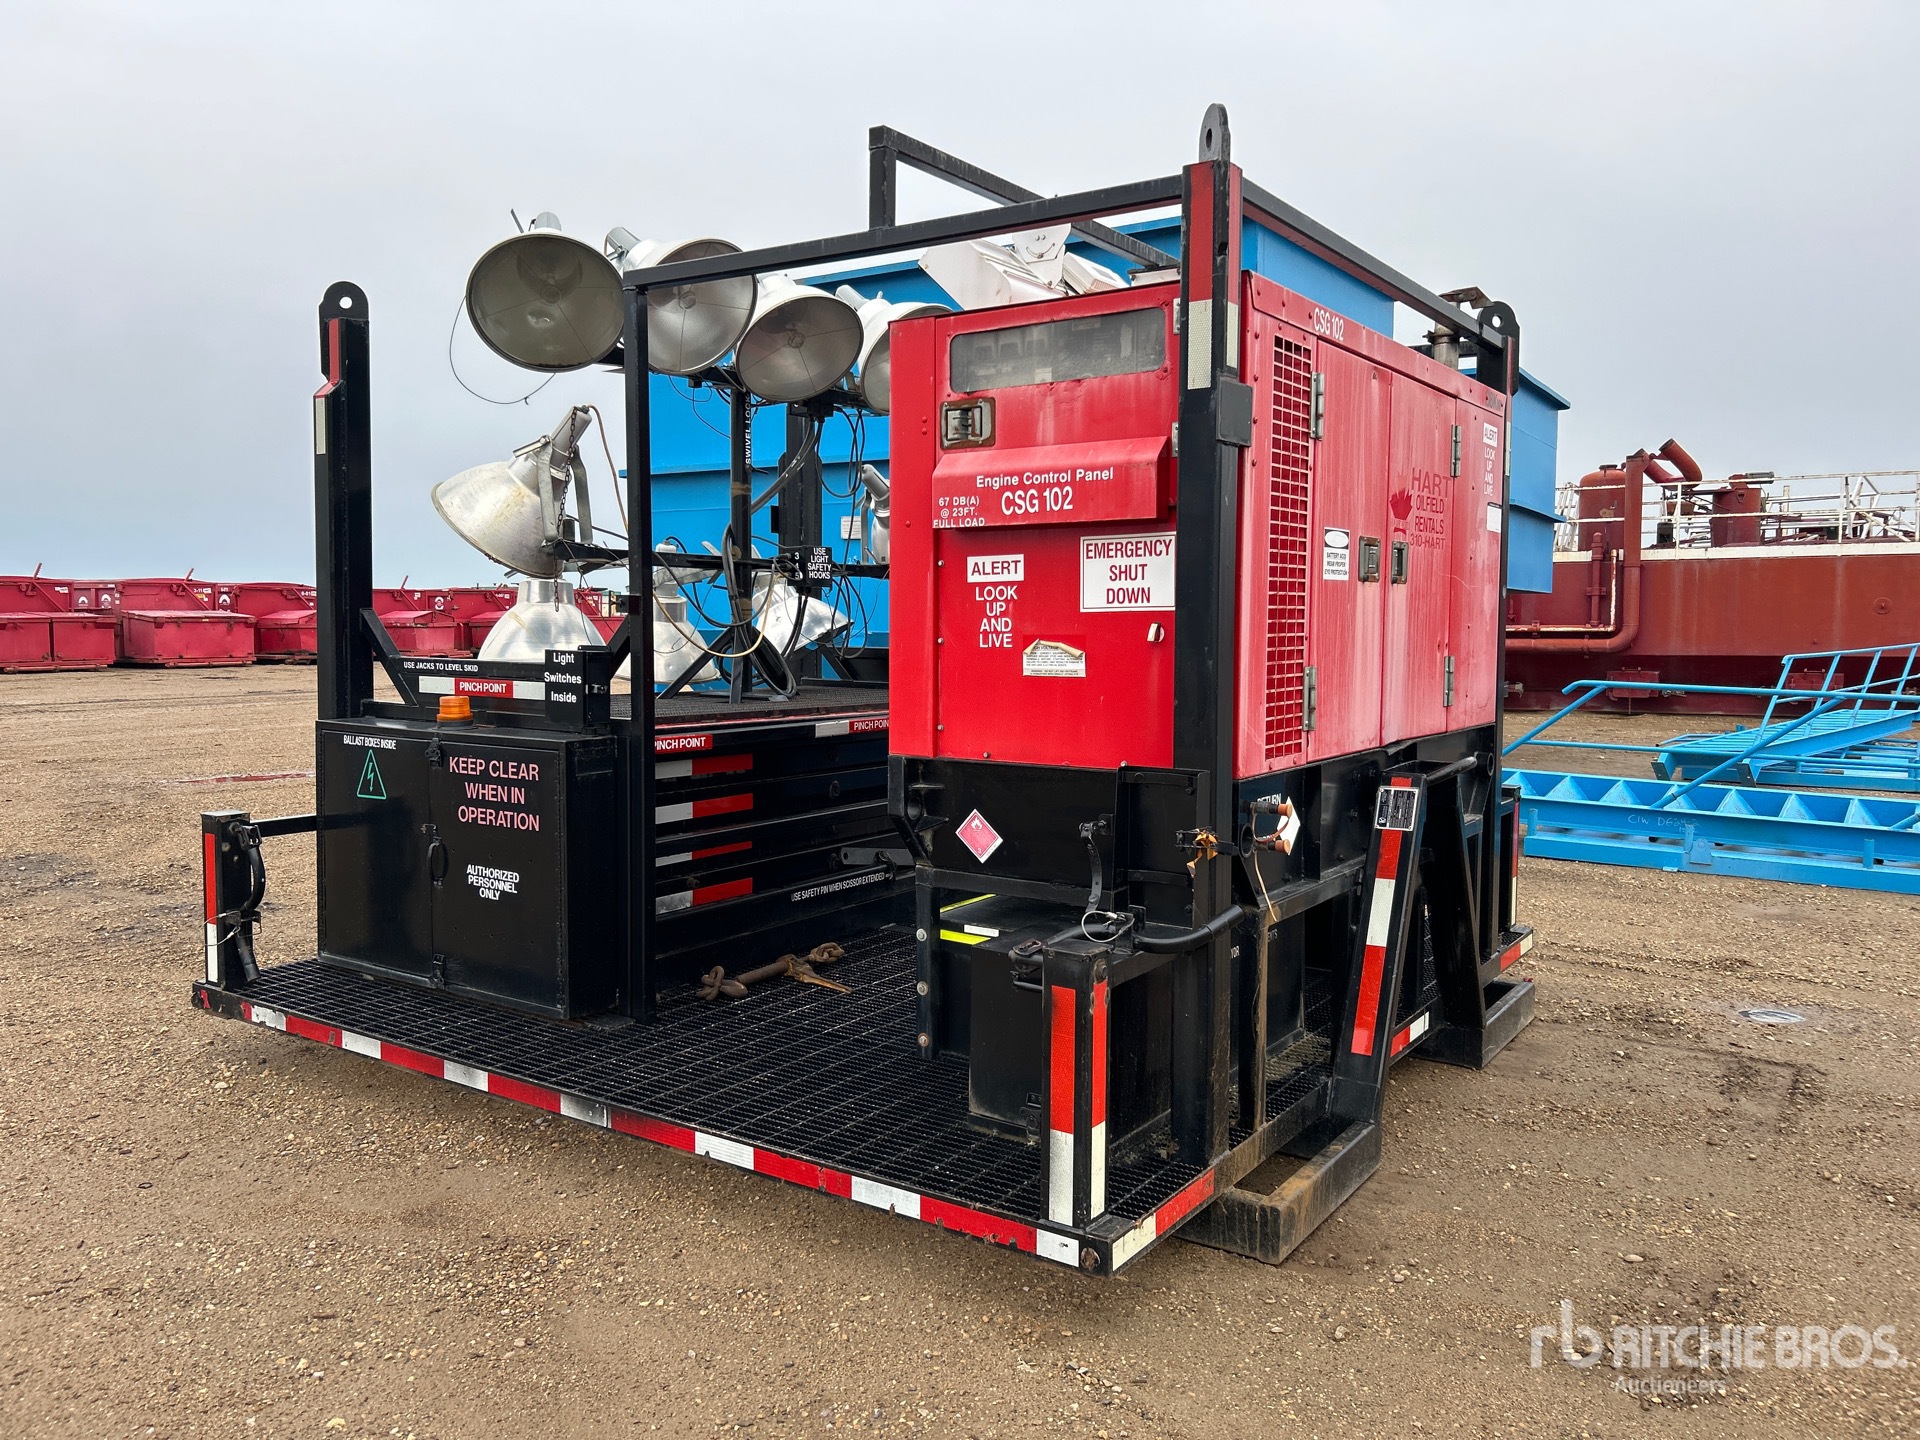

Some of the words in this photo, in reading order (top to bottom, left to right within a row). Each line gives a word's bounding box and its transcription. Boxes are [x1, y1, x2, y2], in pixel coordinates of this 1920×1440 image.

[1313, 307, 1331, 335] CSG
[1331, 315, 1344, 341] 102
[1484, 447, 1496, 461] LOOK
[1486, 460, 1493, 471] UP
[976, 475, 1019, 490] Engine
[1023, 470, 1071, 485] Control
[1076, 467, 1114, 481] Panel
[1411, 467, 1453, 499] HART
[1484, 472, 1494, 484] AND
[1484, 484, 1494, 497] LIVE
[938, 497, 950, 507] 67
[952, 496, 980, 507] DB(A)
[1001, 489, 1039, 515] CSG
[1043, 486, 1073, 511] 102
[1415, 494, 1445, 514] OILFIELD
[940, 509, 950, 518] @
[952, 507, 978, 517] 23FT.
[933, 519, 957, 528] FULL
[958, 518, 985, 528] LOAD
[1414, 516, 1445, 535] RENTALS
[1409, 533, 1446, 550] 310-HART
[794, 552, 800, 560] 3
[813, 547, 827, 555] USE
[1085, 539, 1173, 560] EMERGENCY
[810, 555, 829, 563] LIGHT
[807, 562, 832, 571] SAFETY
[970, 560, 1021, 577] ALERT
[1108, 564, 1148, 582] SHUT
[808, 571, 831, 579] HOOKS
[975, 585, 1018, 600] LOOK
[1106, 587, 1151, 605] DOWN
[986, 602, 1006, 616] UP
[979, 618, 1012, 632] AND
[979, 633, 1013, 648] LIVE
[553, 652, 575, 666] Light
[403, 661, 416, 669] USE
[416, 662, 435, 670] JACKS
[435, 662, 444, 671] TO
[444, 663, 463, 671] LEVEL
[464, 663, 479, 672] SKID
[544, 672, 582, 684] Switches
[459, 681, 482, 692] PINCH
[483, 682, 507, 693] POINT
[551, 691, 577, 704] Inside
[853, 720, 874, 730] PINCH
[874, 719, 889, 728] POIN
[343, 735, 364, 746] BALLAST
[364, 737, 380, 748] BOXES
[380, 738, 397, 749] INSIDE
[680, 737, 706, 748] POINT
[449, 756, 486, 775] KEEP
[489, 760, 539, 781] CLEAR
[464, 782, 508, 803] WHEN
[511, 786, 525, 804] IN
[458, 805, 540, 832] OPERATION
[466, 864, 520, 883] AUTHORIZED
[468, 875, 518, 893] PERSONNEL
[791, 891, 802, 901] USE
[801, 887, 821, 899] SAFETY
[820, 885, 829, 894] PIN
[829, 882, 843, 892] WHEN
[842, 877, 863, 889] SCISSOR
[862, 872, 885, 884] EXTENDED
[479, 887, 501, 900] ONLY
